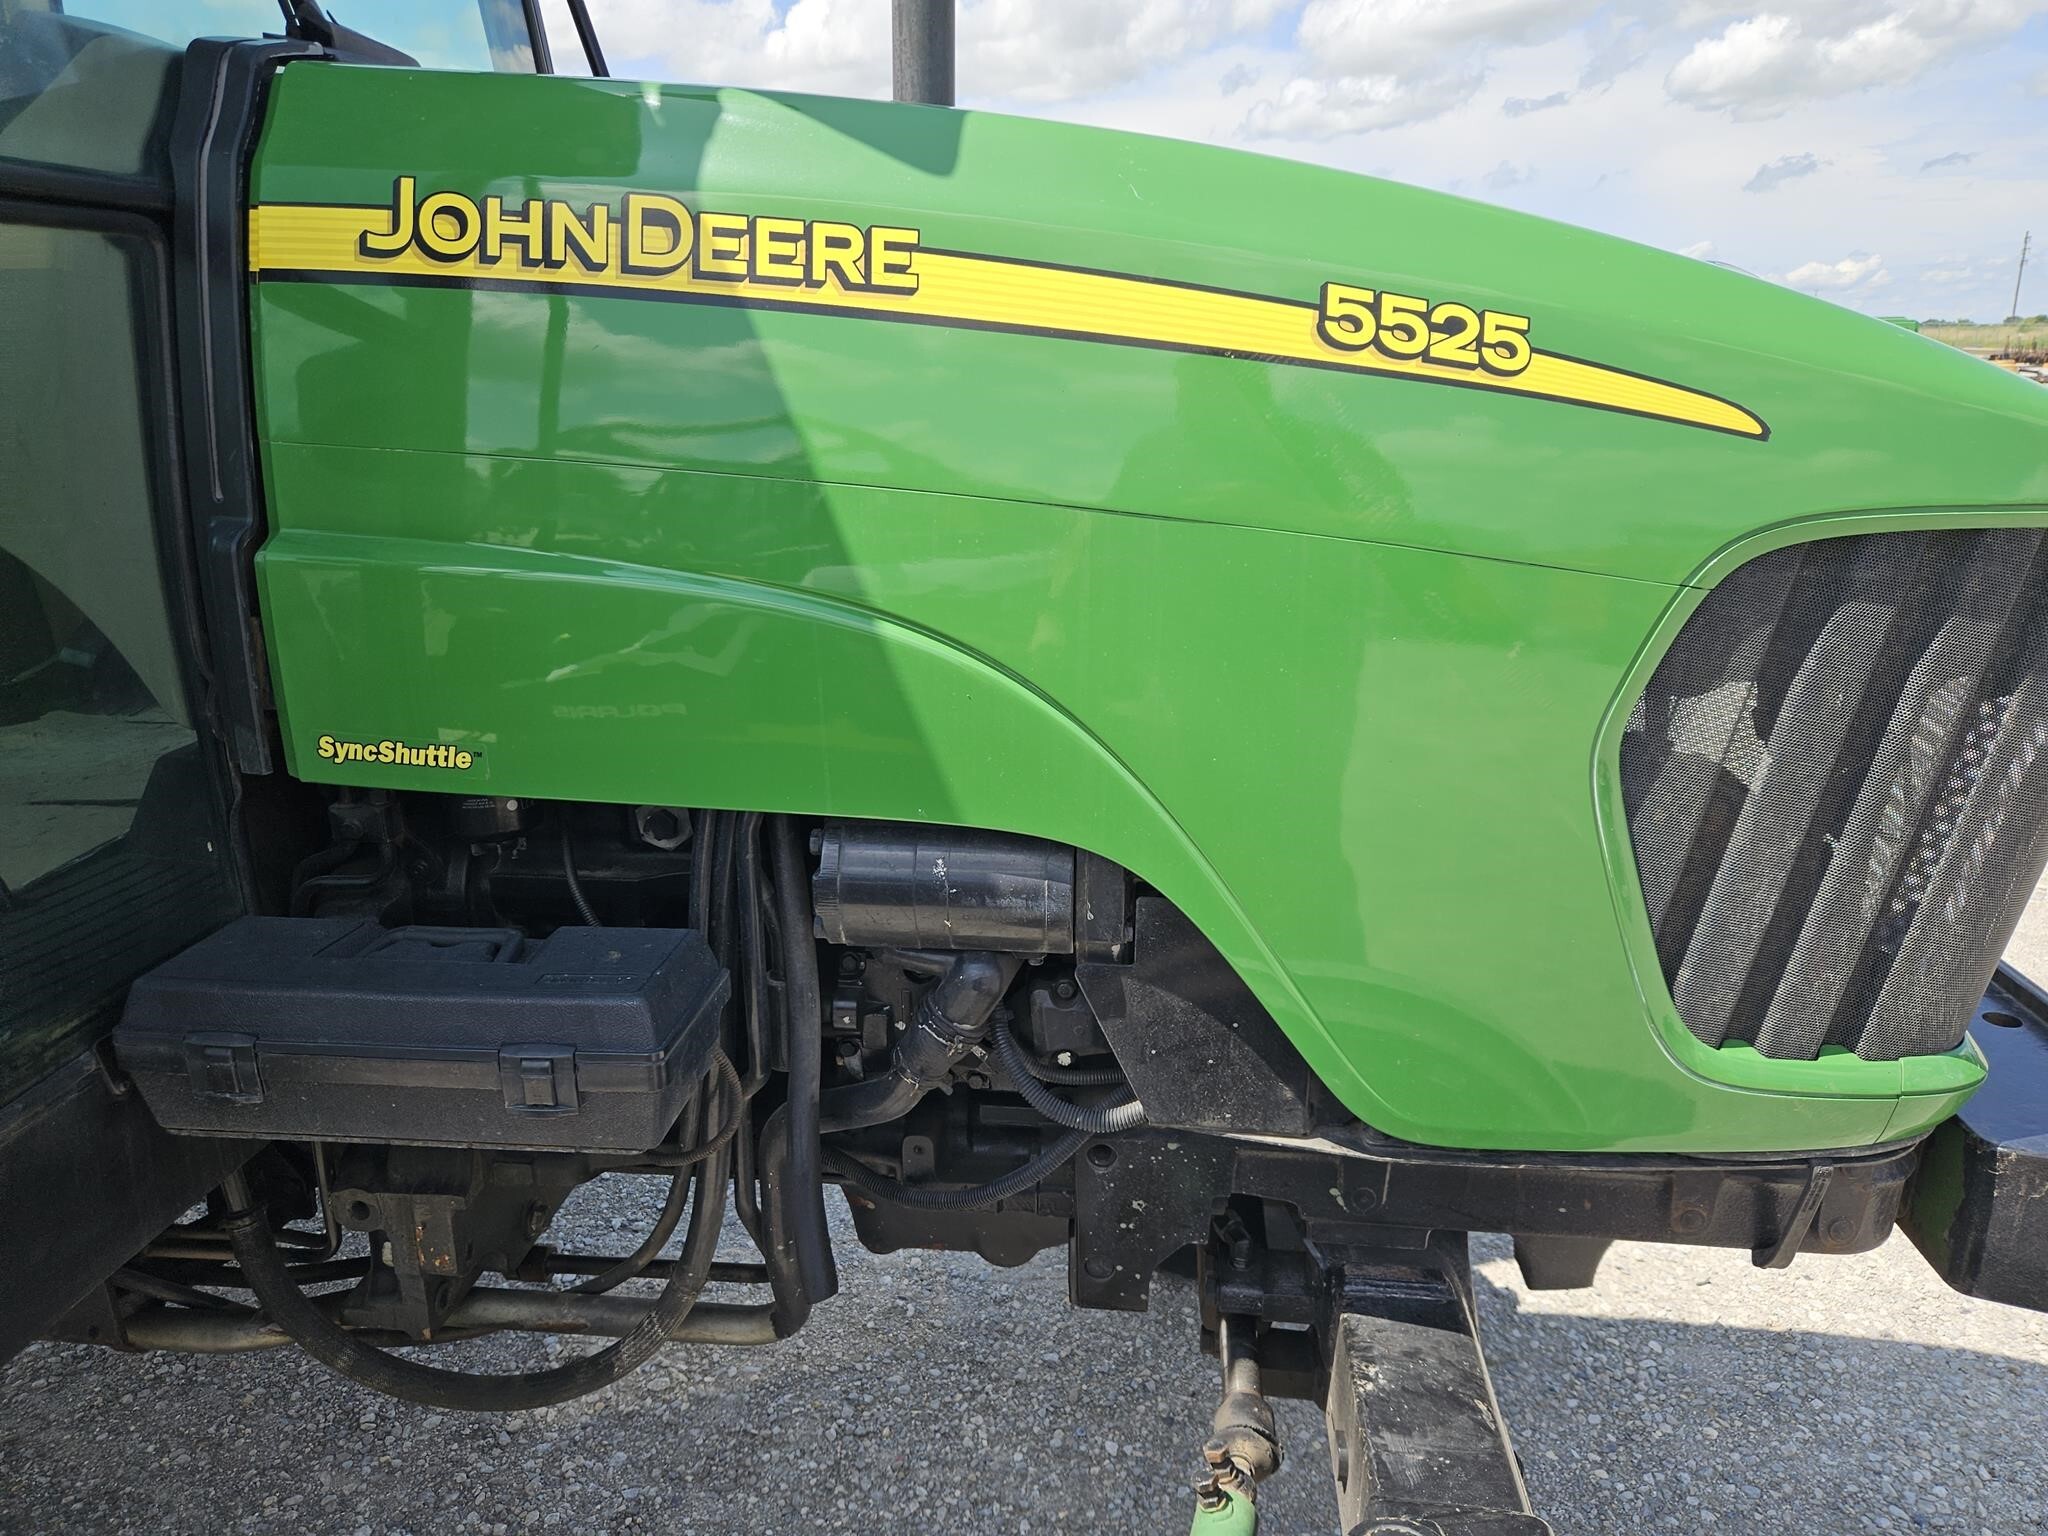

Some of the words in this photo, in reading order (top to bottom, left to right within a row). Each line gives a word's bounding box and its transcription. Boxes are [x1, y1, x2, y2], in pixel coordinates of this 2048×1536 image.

[357, 175, 609, 271] JOHN
[619, 191, 920, 295] DEERE
[1317, 281, 1532, 377] 5525
